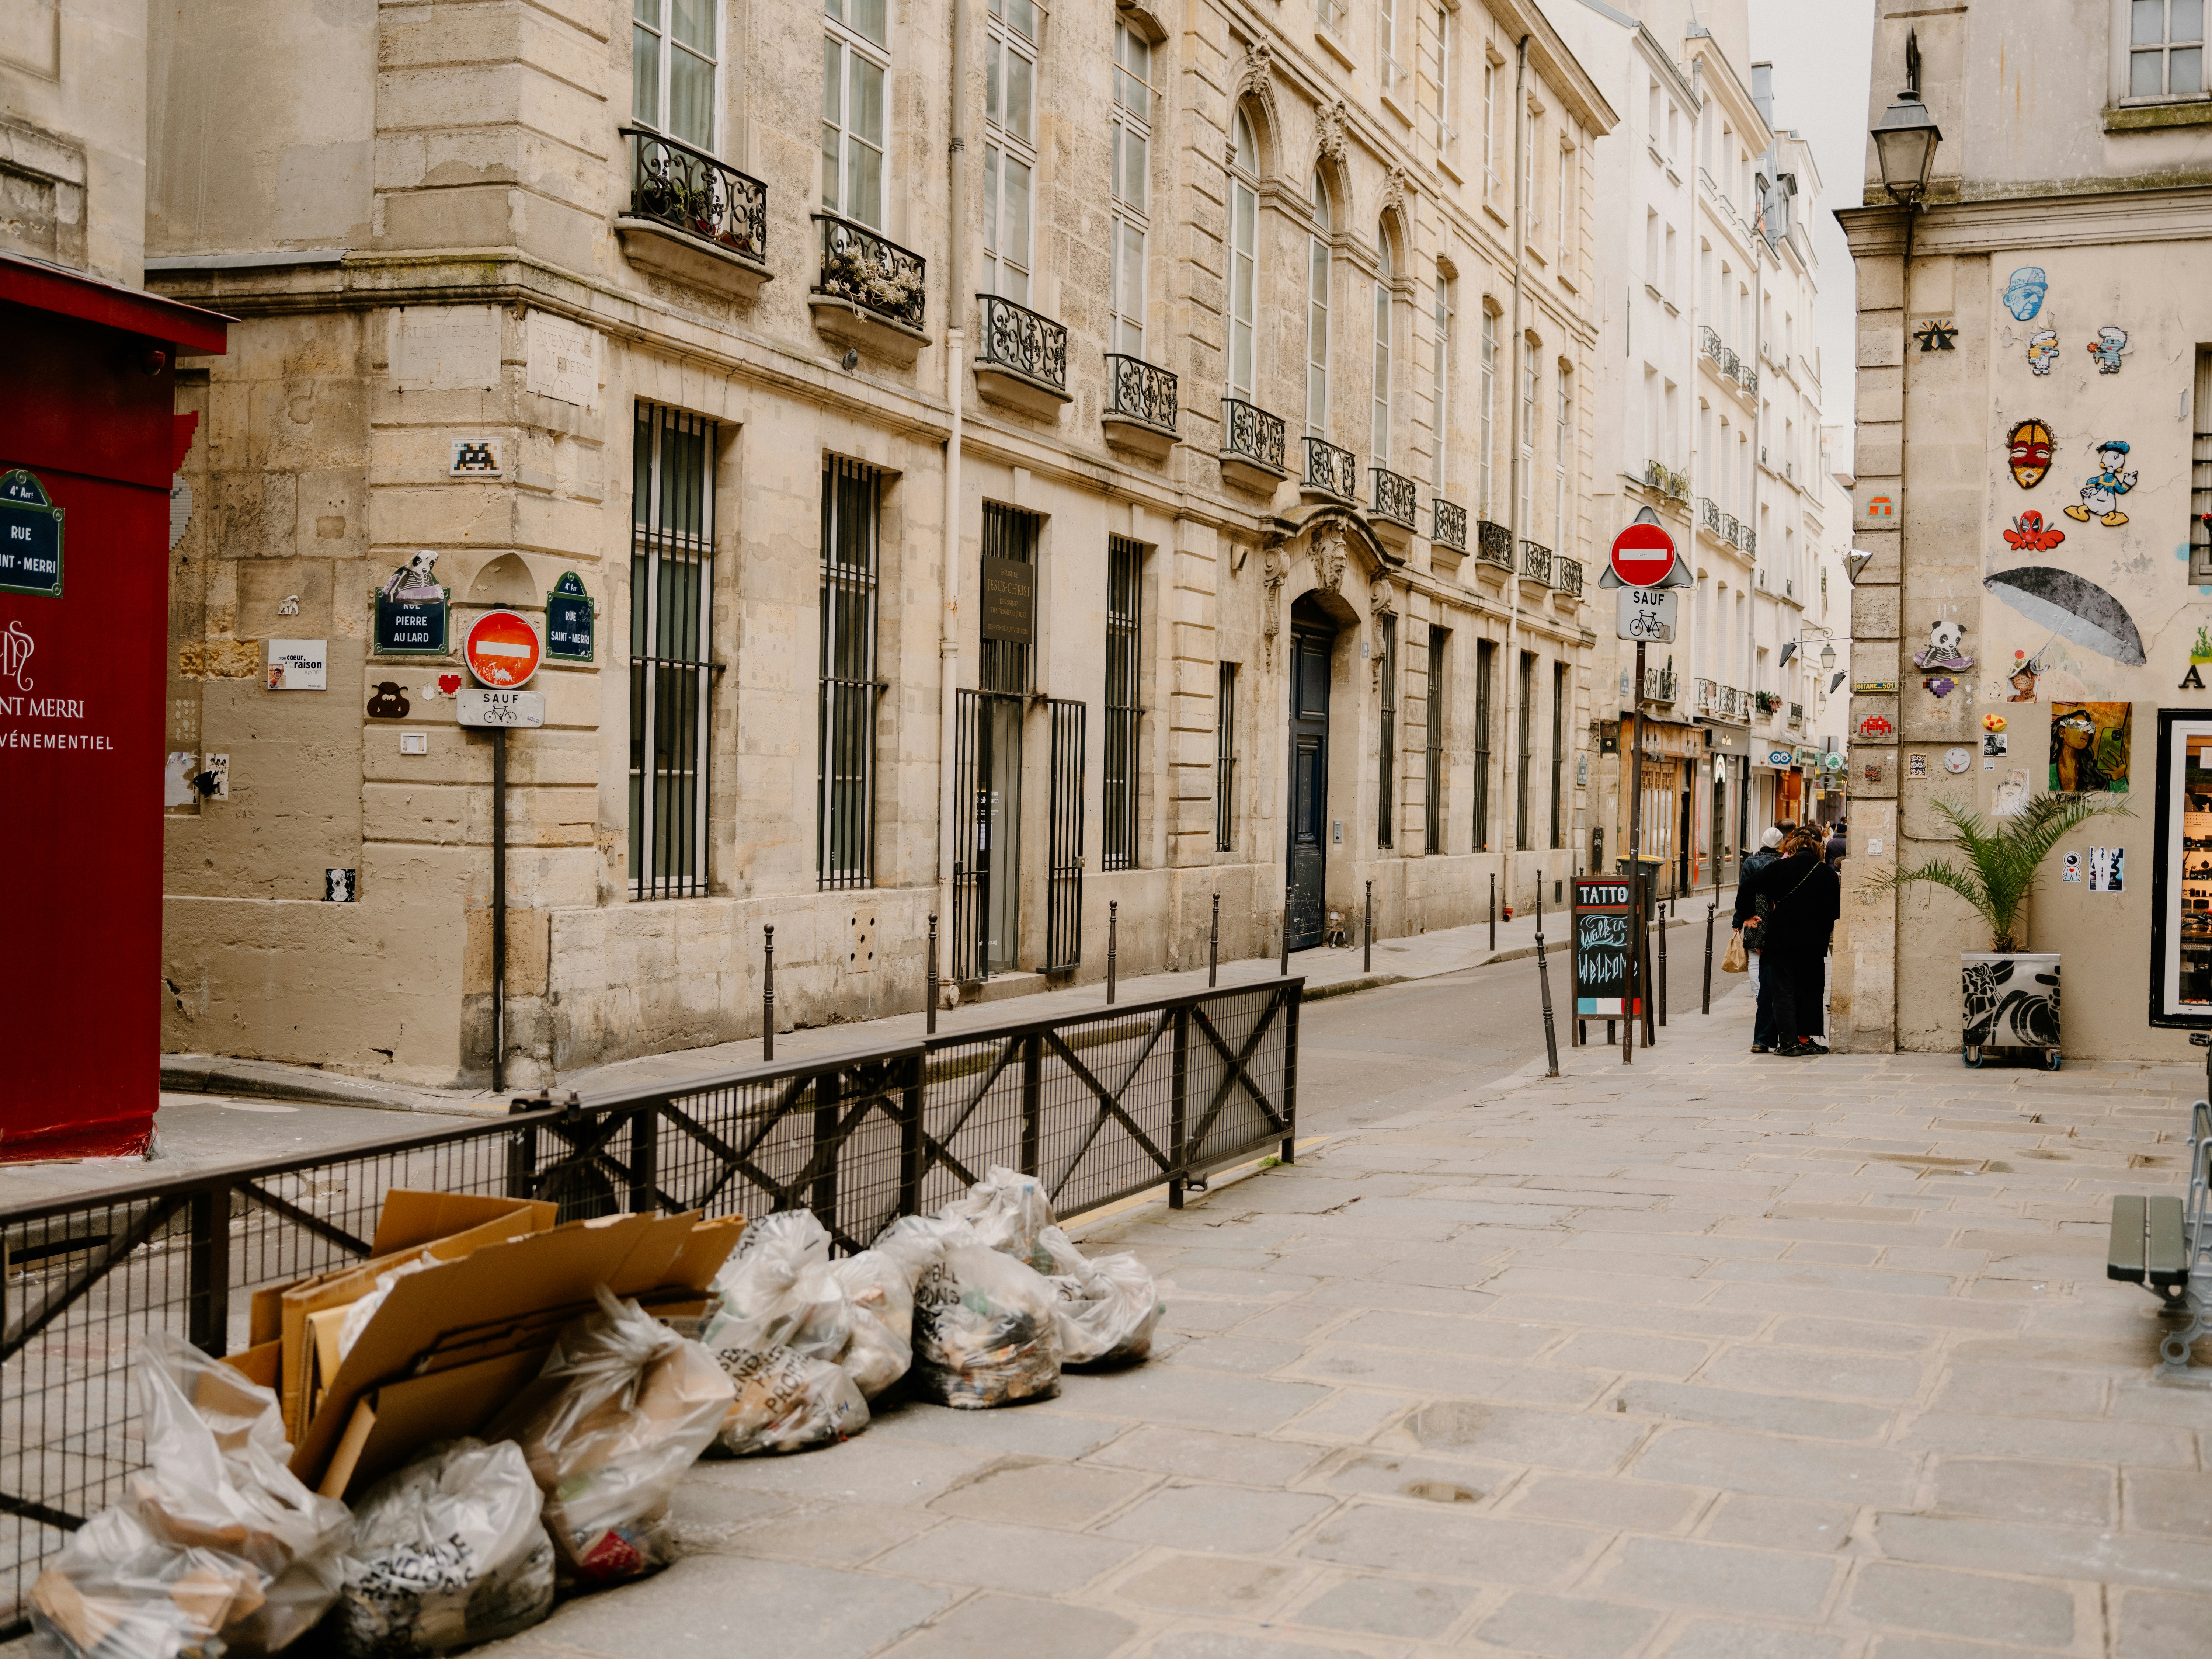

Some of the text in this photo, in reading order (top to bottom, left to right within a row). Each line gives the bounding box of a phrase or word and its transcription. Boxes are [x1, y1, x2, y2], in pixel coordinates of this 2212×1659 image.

[11, 525, 32, 541] RUE
[24, 557, 56, 573] MERRI
[987, 579, 1031, 597] JESUS-CHRIST
[1633, 591, 1665, 606] SAUF
[565, 611, 577, 622] RUE
[998, 608, 1016, 616] DERNIERS
[396, 616, 427, 626] PIERRE
[394, 632, 429, 642] AU LARD
[551, 631, 568, 642] SAINT
[572, 633, 590, 645] MERRI
[2178, 664, 2206, 689] A
[483, 693, 518, 703] SAUF
[29, 698, 84, 718] MERRI
[0, 730, 114, 750] VÉNEMENTIEL
[1580, 886, 1629, 904] TATTO
